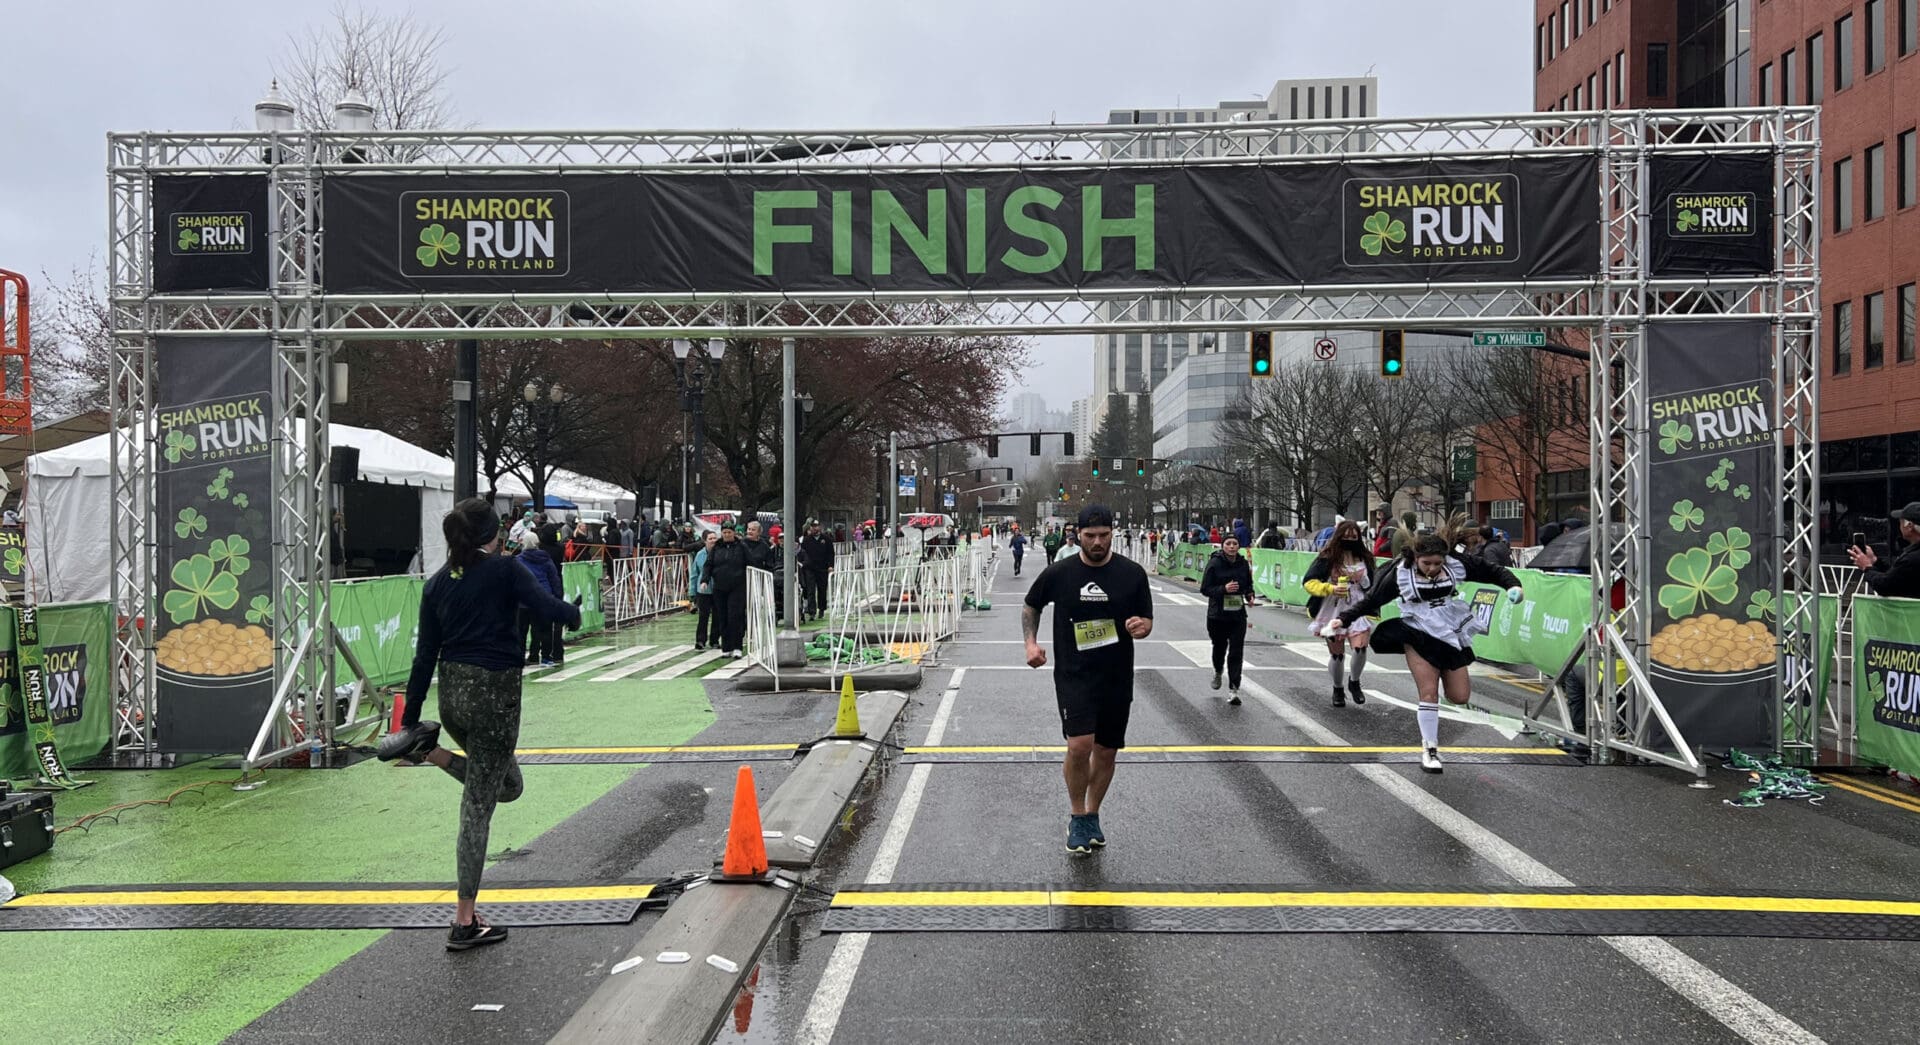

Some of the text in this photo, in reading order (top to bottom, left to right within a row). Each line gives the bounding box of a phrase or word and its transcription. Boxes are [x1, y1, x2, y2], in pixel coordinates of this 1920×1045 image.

[1360, 182, 1503, 207] SHAMROCK
[1675, 196, 1747, 208] SHAMROCK
[416, 198, 554, 220] SHAMROCK
[1702, 207, 1748, 227] RUN
[177, 215, 244, 227] SHAMROCK
[753, 184, 1155, 276] FINISH
[1413, 205, 1504, 246] RUN
[202, 226, 245, 245] RUN
[467, 220, 555, 258] RUN
[1413, 245, 1504, 257] PORTLAND
[467, 259, 555, 270] PORTLAND
[1487, 334, 1543, 345] SW YAMHILL ST
[1652, 385, 1762, 419] SHAMROCK
[160, 398, 262, 429] SHAMROCK
[1695, 403, 1769, 442] RUN
[199, 415, 268, 452] RUN
[1700, 433, 1770, 451] PORTLAND
[202, 444, 269, 460] PORTLAND
[1085, 628, 1107, 640] 1331
[29, 669, 43, 701] RUN
[42, 746, 63, 776] RUN
